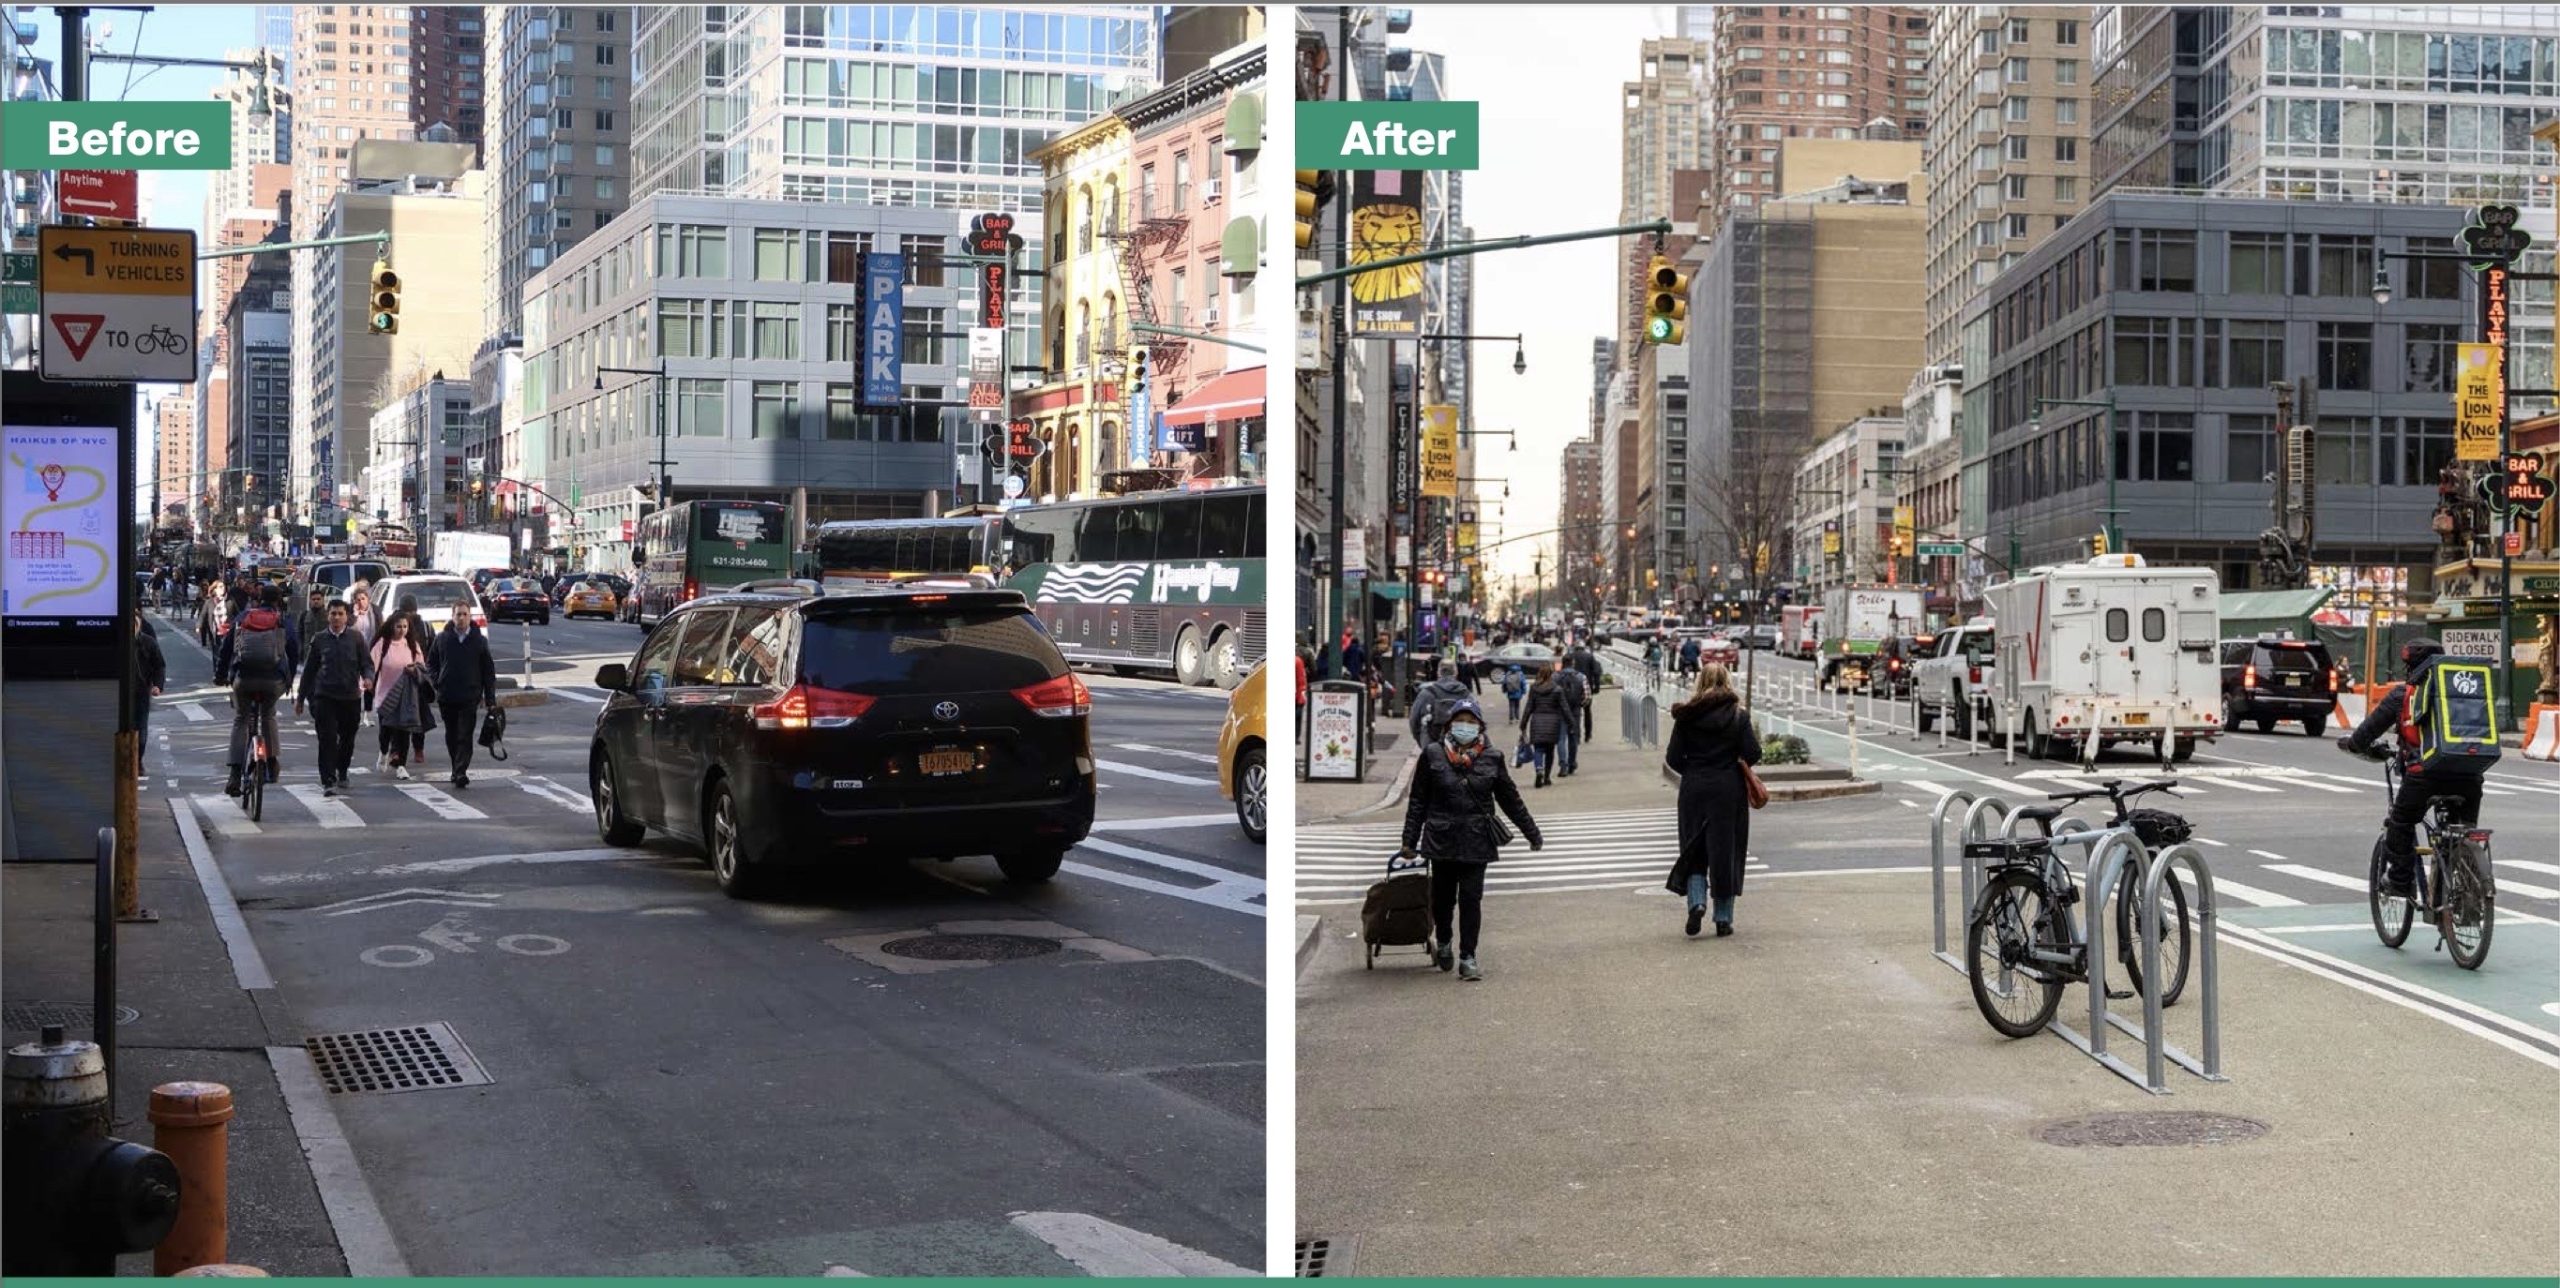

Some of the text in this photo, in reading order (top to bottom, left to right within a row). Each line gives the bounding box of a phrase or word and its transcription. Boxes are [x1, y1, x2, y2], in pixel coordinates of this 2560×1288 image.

[64, 174, 104, 188] Anytime
[986, 218, 1009, 229] BAR
[993, 230, 1001, 239] &
[109, 241, 180, 257] TURNING
[981, 240, 1006, 250] GRIL
[21, 256, 34, 268] ST
[105, 265, 185, 281] VEHICLES
[1357, 310, 1402, 321] THE SHOW
[872, 276, 896, 381] PARK
[105, 331, 129, 347] TO
[973, 384, 1000, 394] ALL
[2468, 385, 2488, 396] THE
[970, 394, 1003, 406] RISE
[2463, 400, 2491, 418] LION
[1166, 431, 1194, 442] GIFT
[2460, 421, 2495, 441] KING
[61, 437, 78, 445] OF
[82, 437, 108, 445] NYC
[1015, 434, 1022, 443] &
[1431, 438, 1448, 447] THE
[1002, 445, 1035, 455] RILL
[1397, 406, 1407, 503] CITY ROOMS
[1428, 450, 1452, 464] LION
[2509, 459, 2538, 471] BAR
[1425, 466, 1454, 481] KING
[2518, 473, 2528, 484] &
[2446, 632, 2500, 643] SIDEWALK
[2451, 645, 2495, 656] CLOSED
